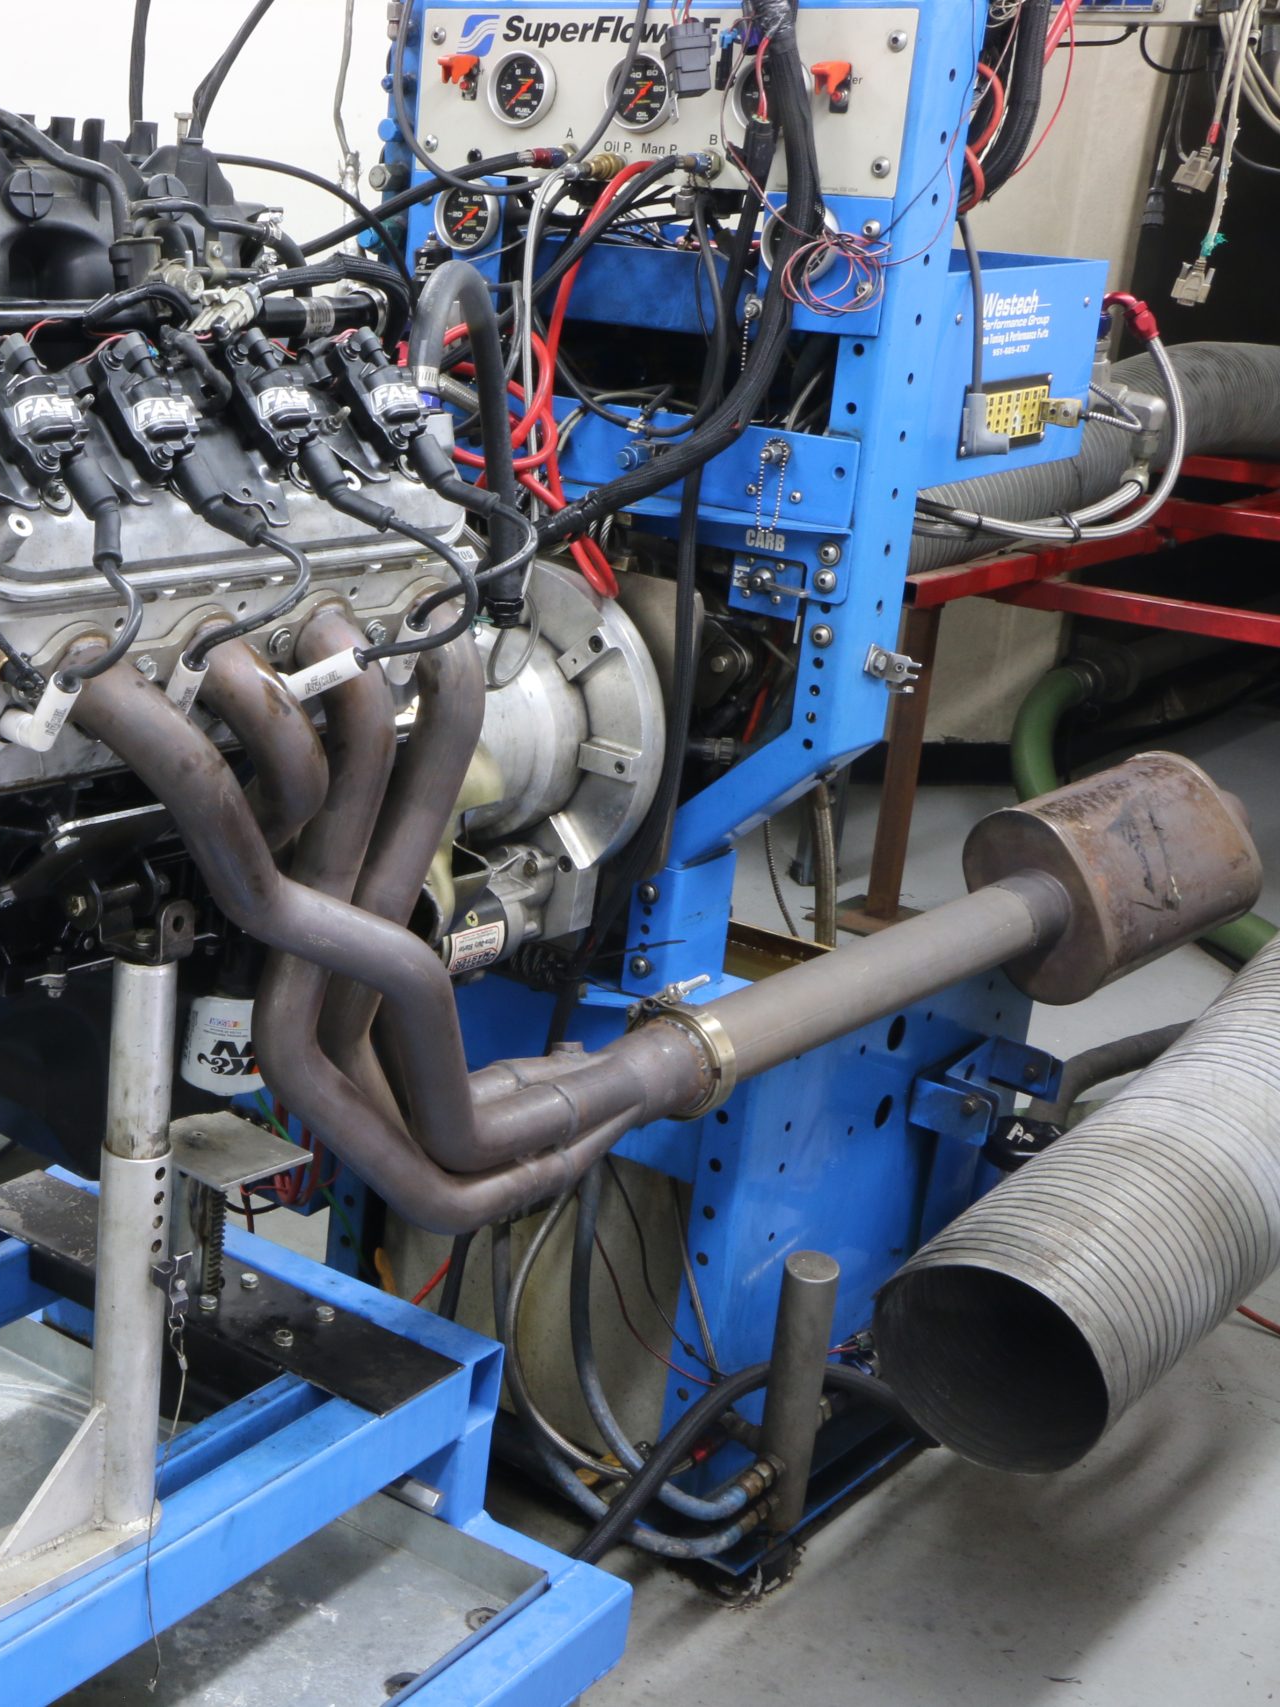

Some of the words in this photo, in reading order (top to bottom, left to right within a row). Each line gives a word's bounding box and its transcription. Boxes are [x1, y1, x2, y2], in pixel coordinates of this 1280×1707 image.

[502, 15, 667, 48] SuperFlow
[566, 127, 574, 139] A
[709, 134, 718, 146] B
[603, 140, 620, 153] Oil
[623, 142, 633, 153] P.
[641, 143, 666, 155] Man
[983, 289, 1039, 318] Westech
[1028, 315, 1050, 326] Group
[21, 397, 75, 421] FAST
[137, 399, 189, 422] FAST
[261, 388, 310, 412] FAST
[745, 529, 785, 552] CARB
